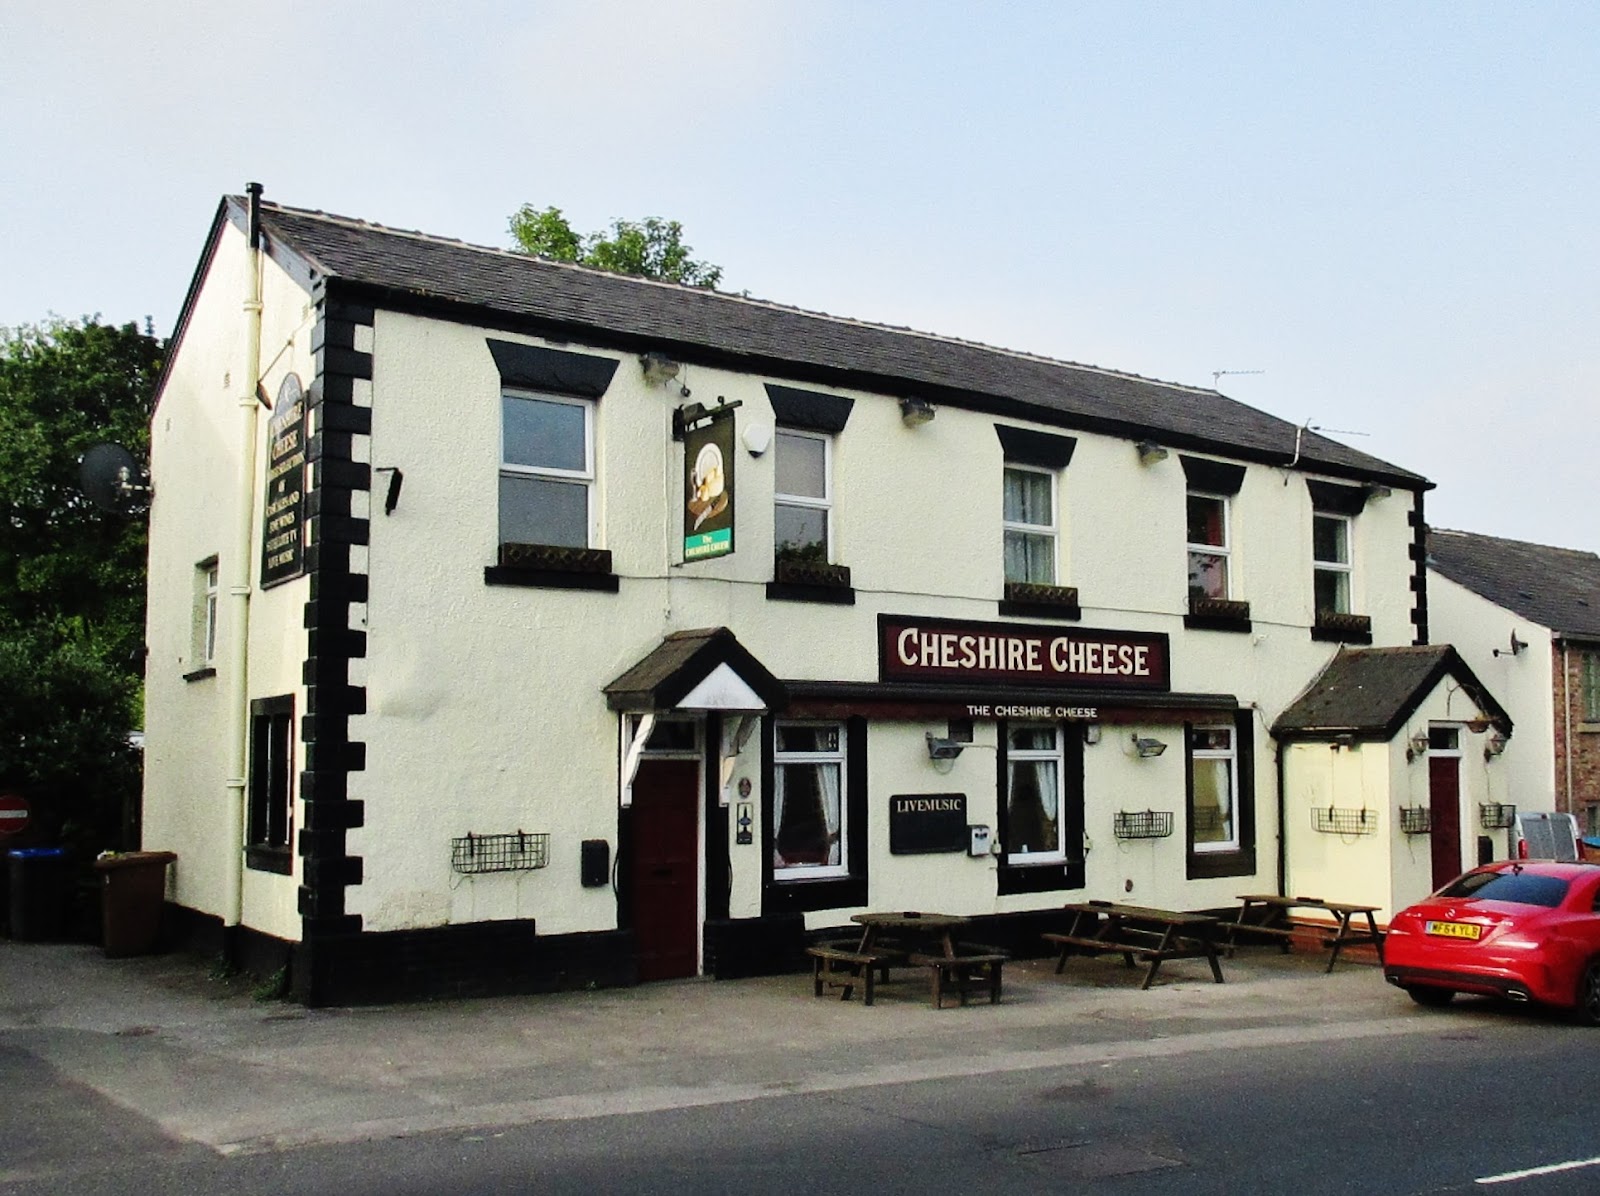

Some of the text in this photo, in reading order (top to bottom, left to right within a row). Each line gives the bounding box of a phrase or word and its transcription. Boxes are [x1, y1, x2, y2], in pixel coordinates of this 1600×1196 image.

[898, 627, 1150, 676] CHESHIRE CHEESE
[966, 705, 1098, 718] THE CHESHIRE CHEESE
